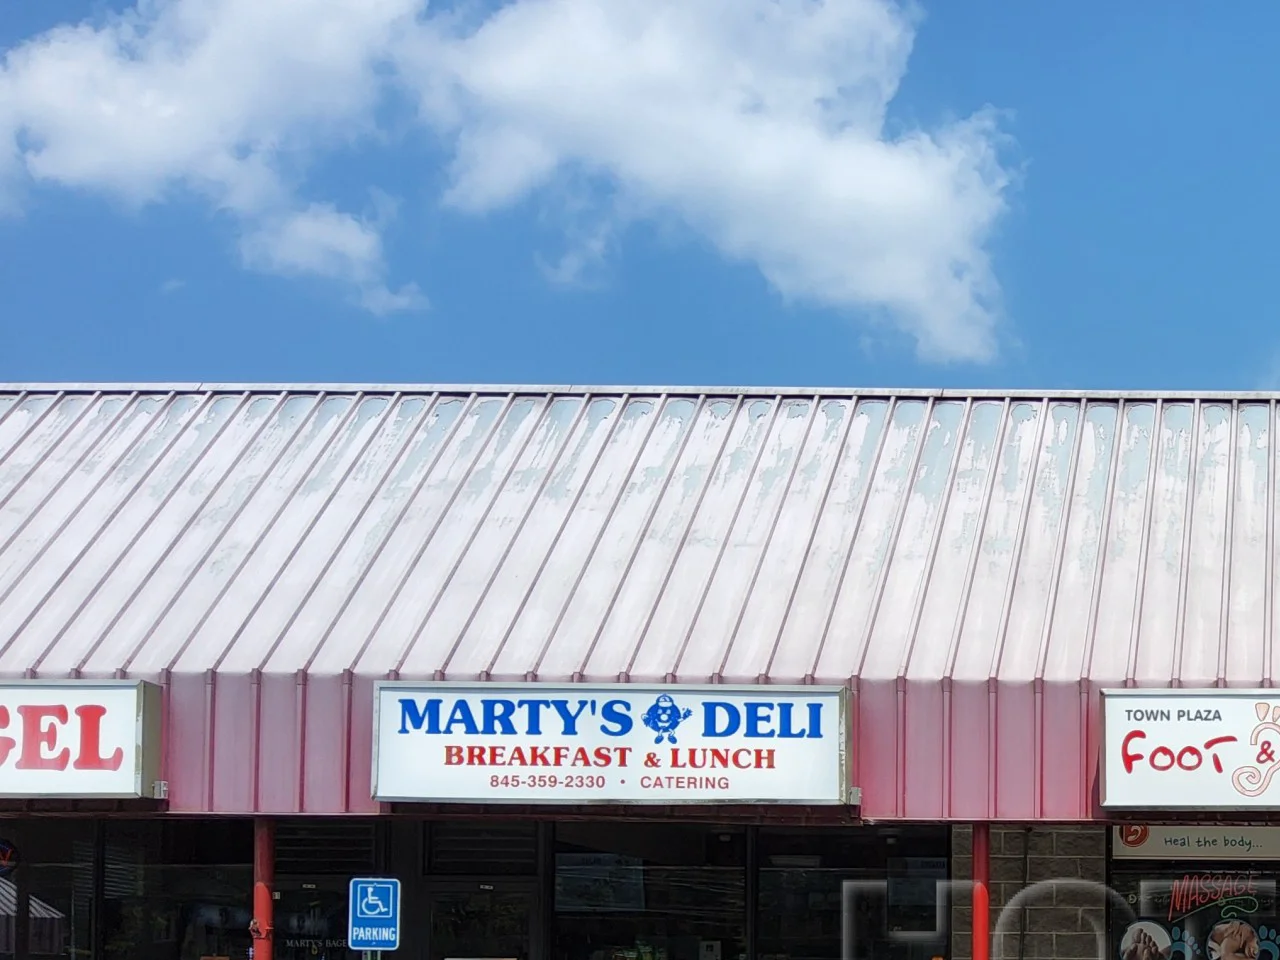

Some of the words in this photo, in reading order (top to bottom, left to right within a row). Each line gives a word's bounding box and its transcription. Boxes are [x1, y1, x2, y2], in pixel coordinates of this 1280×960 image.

[398, 698, 632, 736] MARTY'S
[701, 702, 824, 739] DELI
[1125, 709, 1171, 722] TOWN
[1176, 709, 1222, 722] PLAZA
[0, 704, 123, 771] EL
[444, 745, 632, 768] BREAKFAST
[644, 751, 661, 768] &
[670, 748, 775, 769] LUNCH
[1121, 729, 1238, 775] FOOT
[1256, 741, 1275, 763] &
[489, 775, 606, 789] 845-359-2330
[640, 776, 729, 790] CATERING
[1164, 836, 1190, 847] Heal
[1195, 836, 1217, 847] the
[1167, 873, 1259, 922] MASSAGE
[353, 927, 396, 941] PARKING
